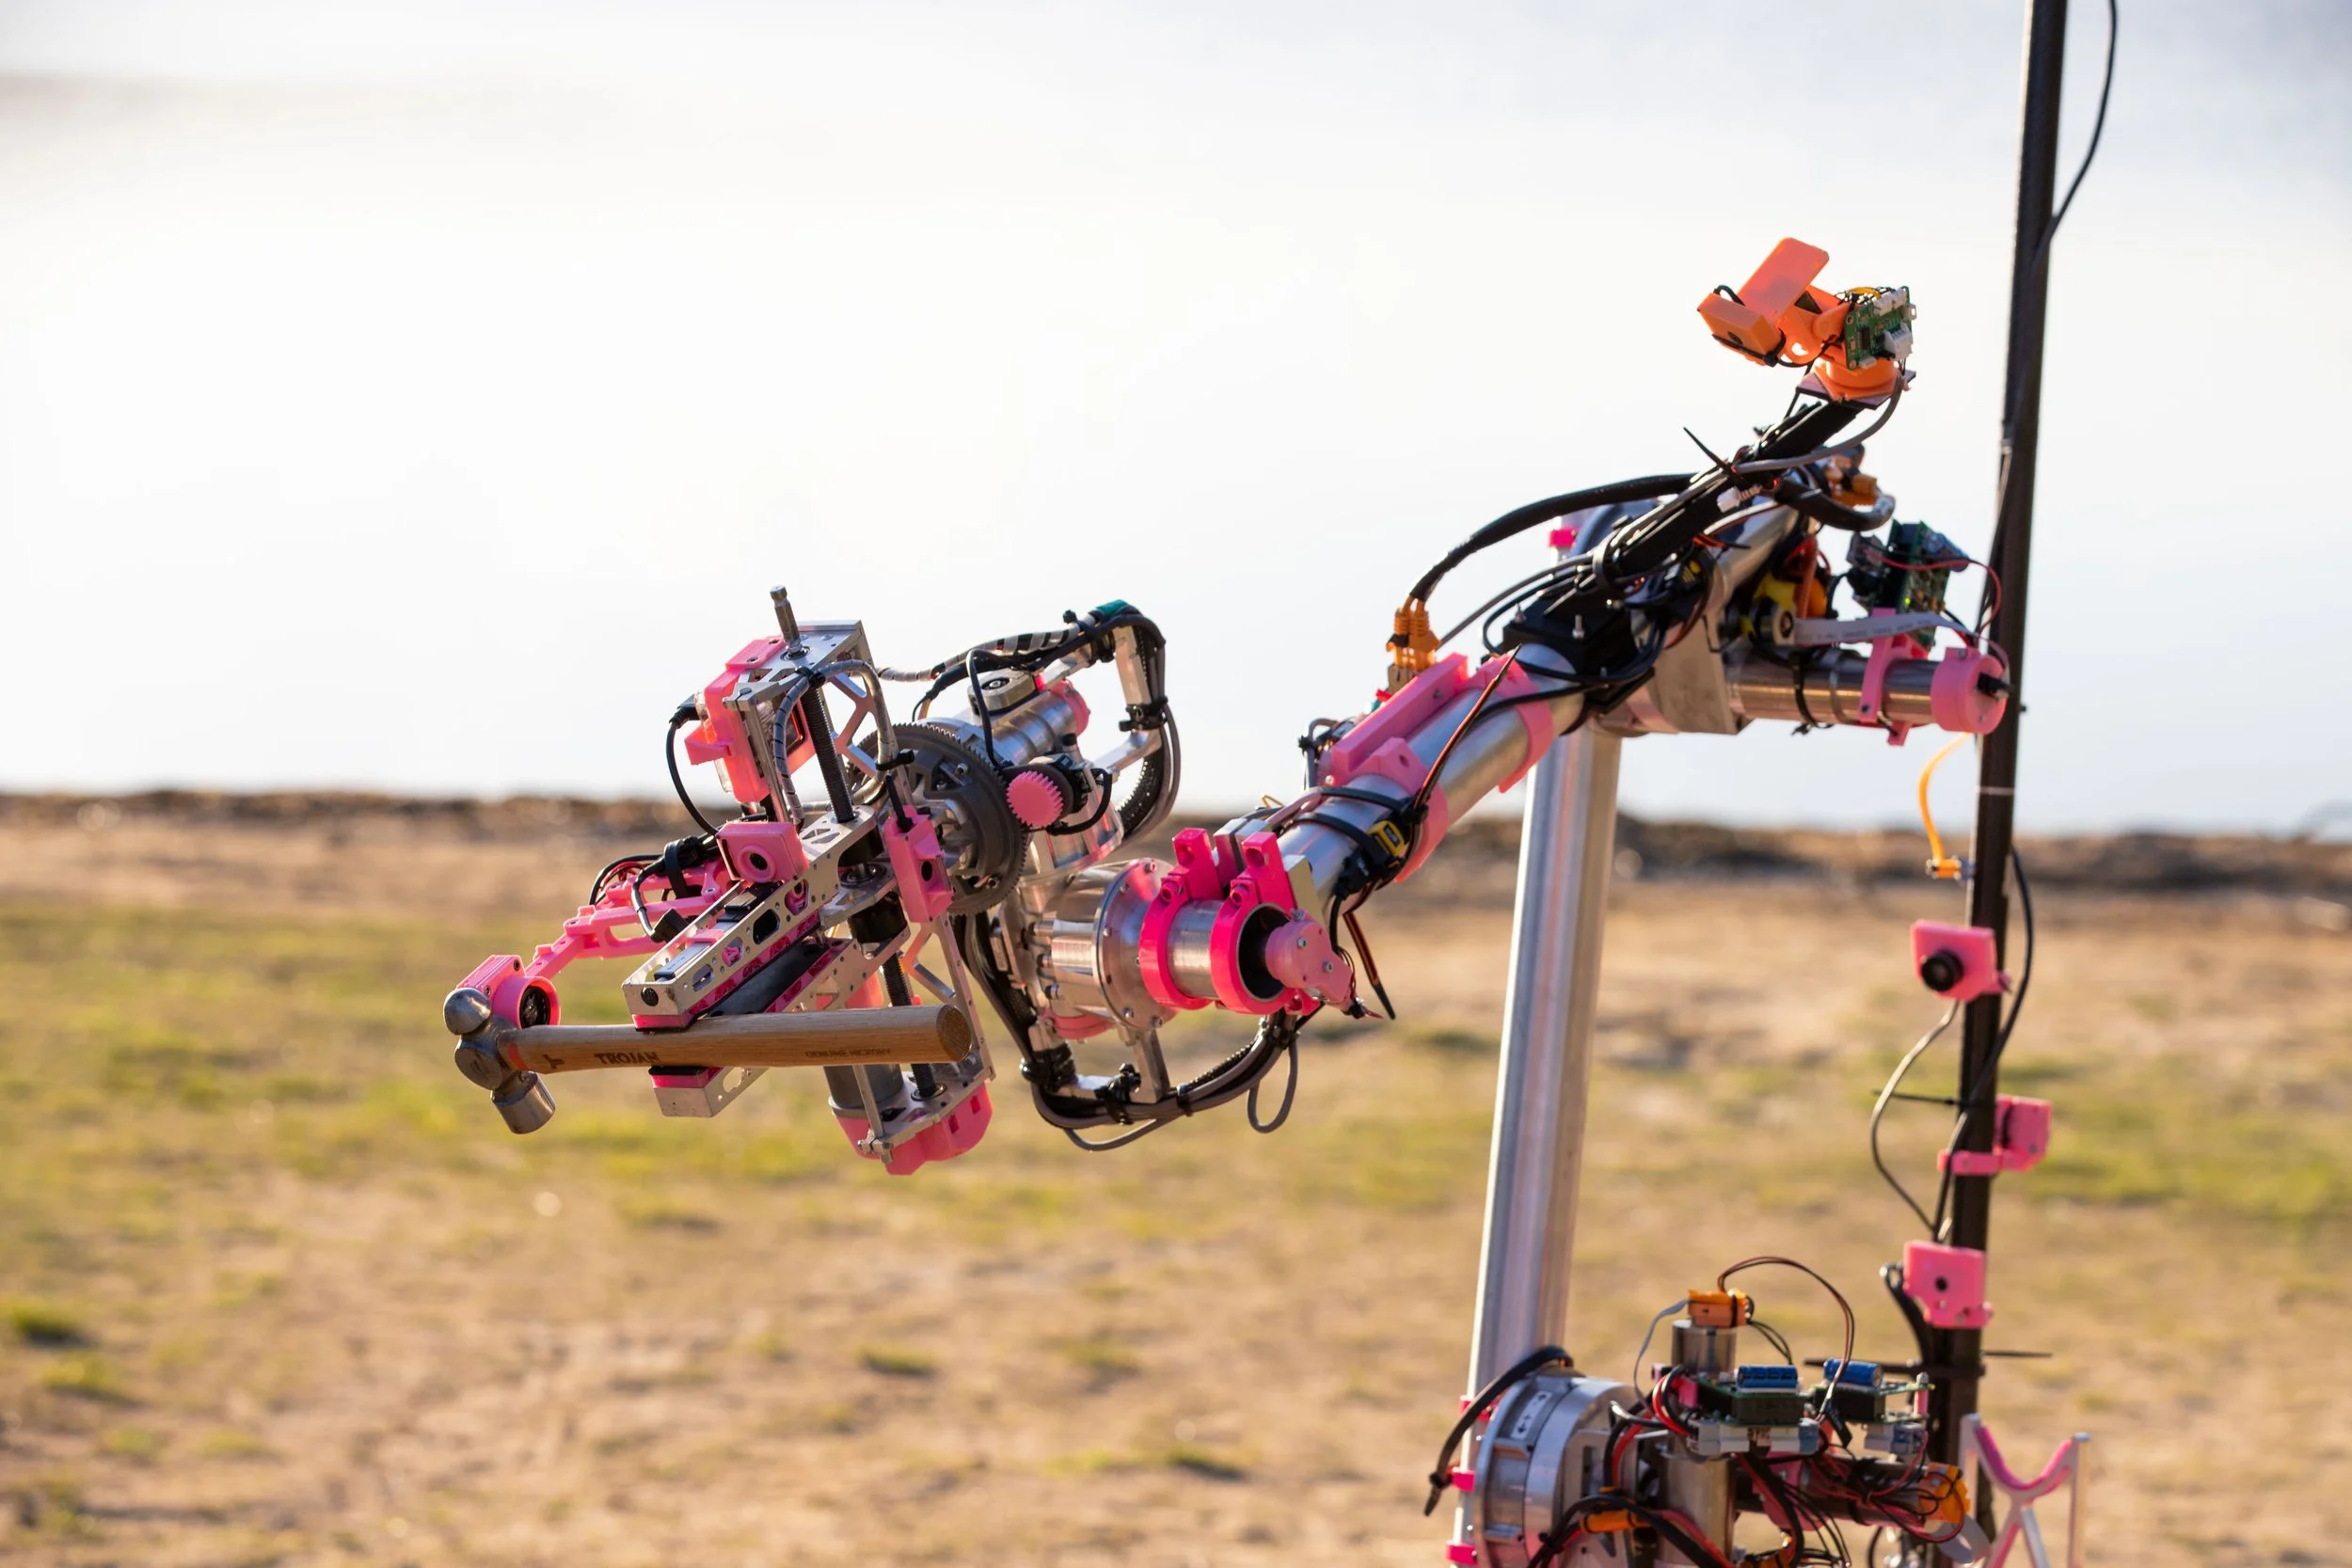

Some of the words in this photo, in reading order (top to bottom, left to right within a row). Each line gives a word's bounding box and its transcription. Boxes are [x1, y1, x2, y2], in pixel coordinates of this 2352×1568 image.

[594, 1052, 660, 1065] TROJAN
[805, 1050, 847, 1058] GENUINE
[849, 1048, 891, 1056] HICKORY
